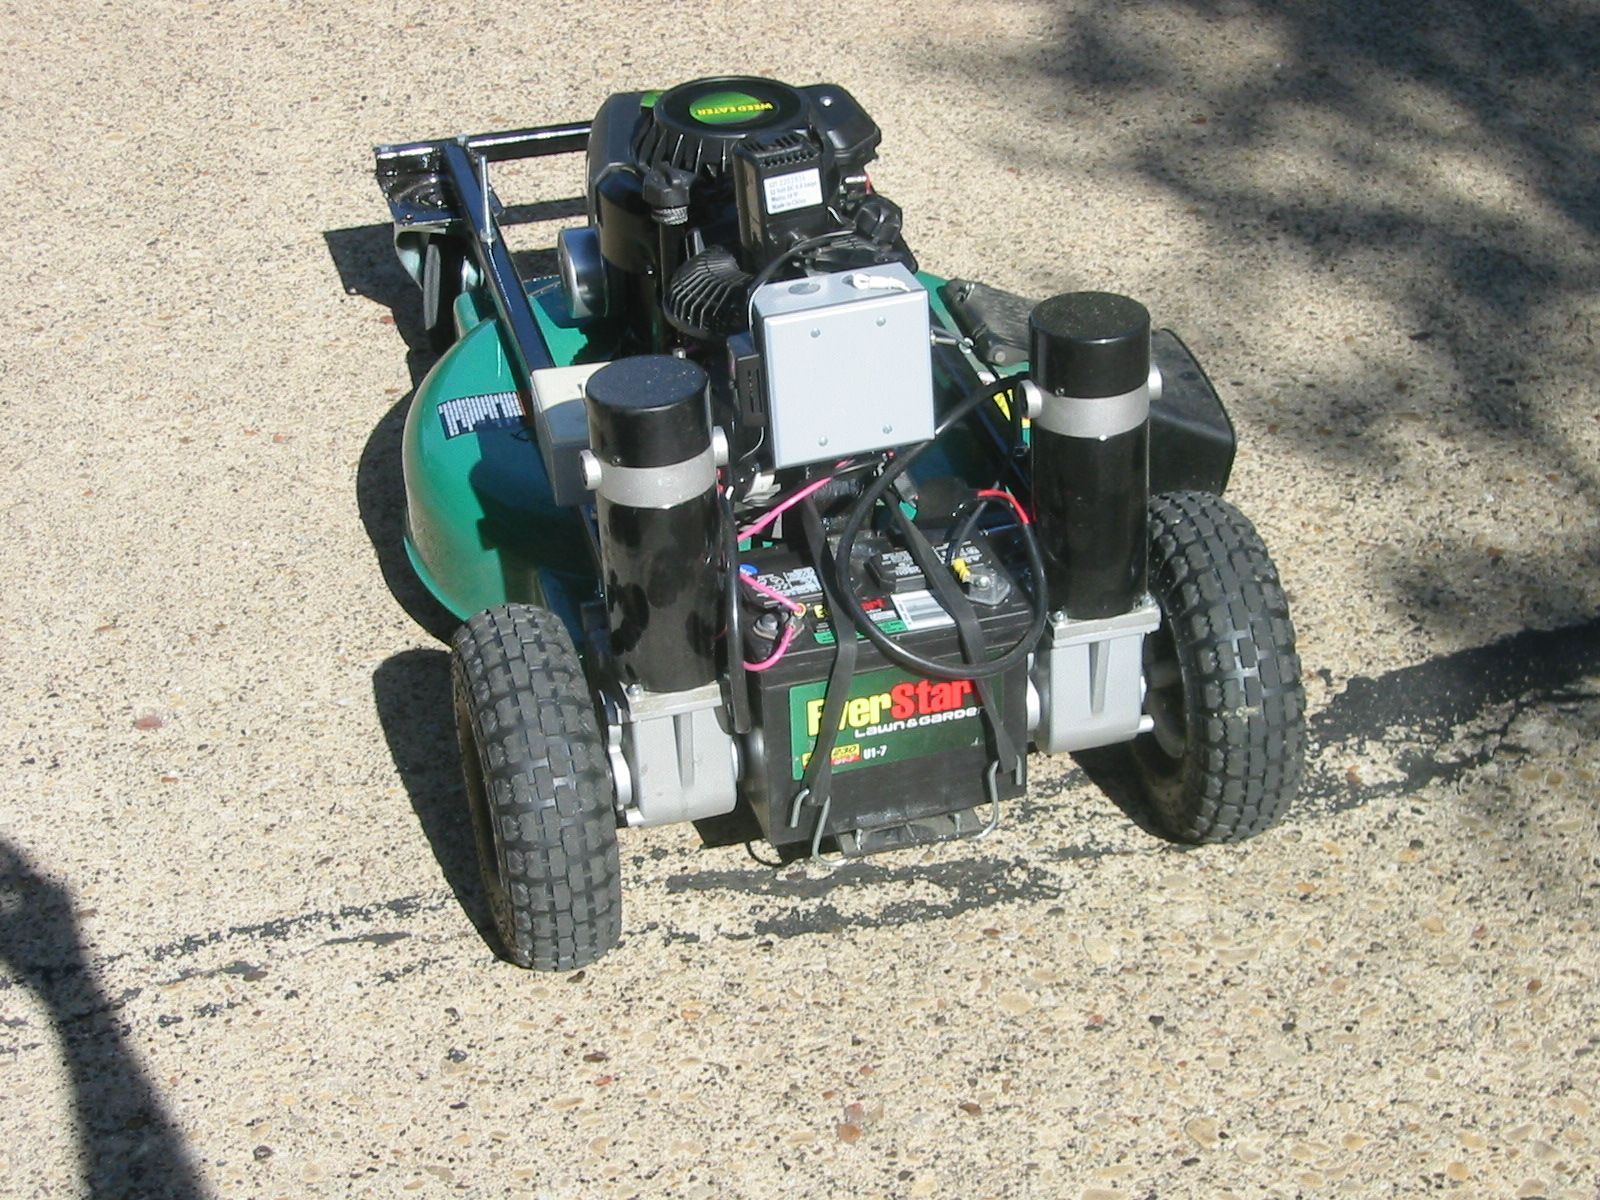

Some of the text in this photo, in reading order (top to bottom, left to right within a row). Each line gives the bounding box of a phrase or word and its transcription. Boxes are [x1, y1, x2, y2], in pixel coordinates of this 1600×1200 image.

[696, 102, 774, 116] WEED EATER
[806, 679, 985, 737] EerStar
